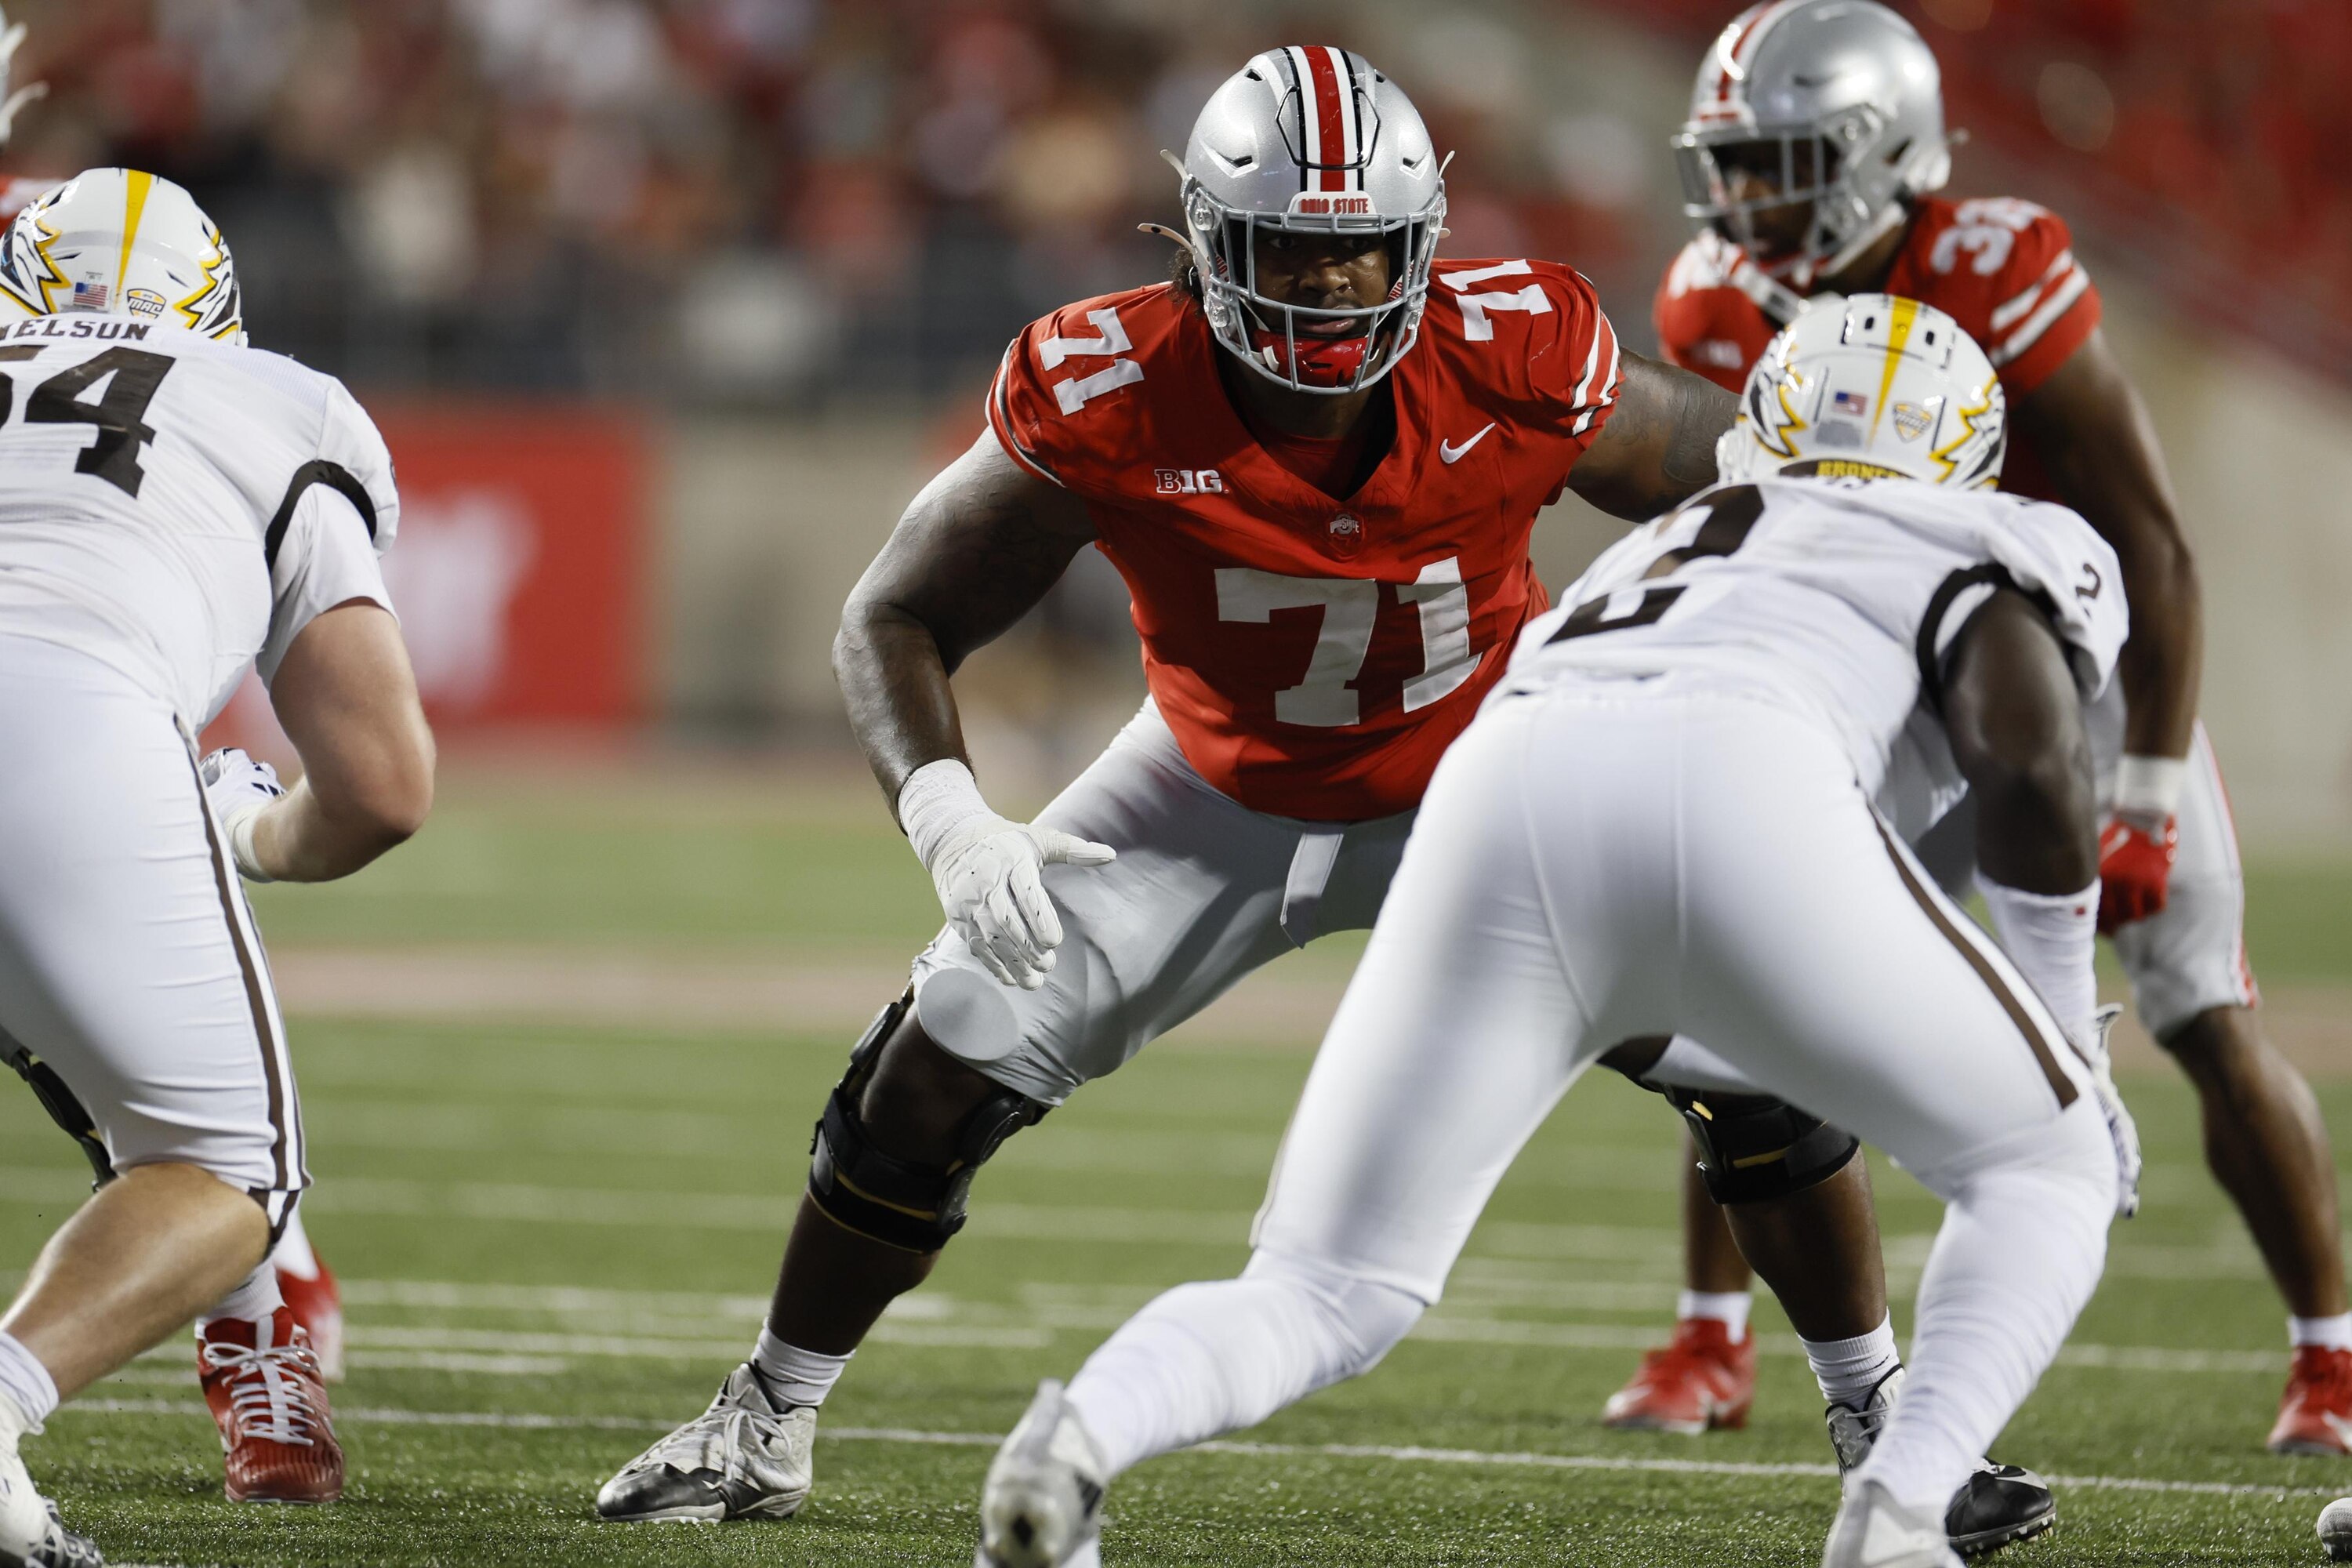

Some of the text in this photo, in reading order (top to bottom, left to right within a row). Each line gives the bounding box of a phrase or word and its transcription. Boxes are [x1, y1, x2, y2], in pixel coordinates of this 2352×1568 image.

[1299, 198, 1369, 214] OHIO STATE
[128, 297, 164, 315] MAC
[1438, 259, 1553, 341] 71
[1038, 307, 1145, 416] 71
[1214, 556, 1483, 728] 71
